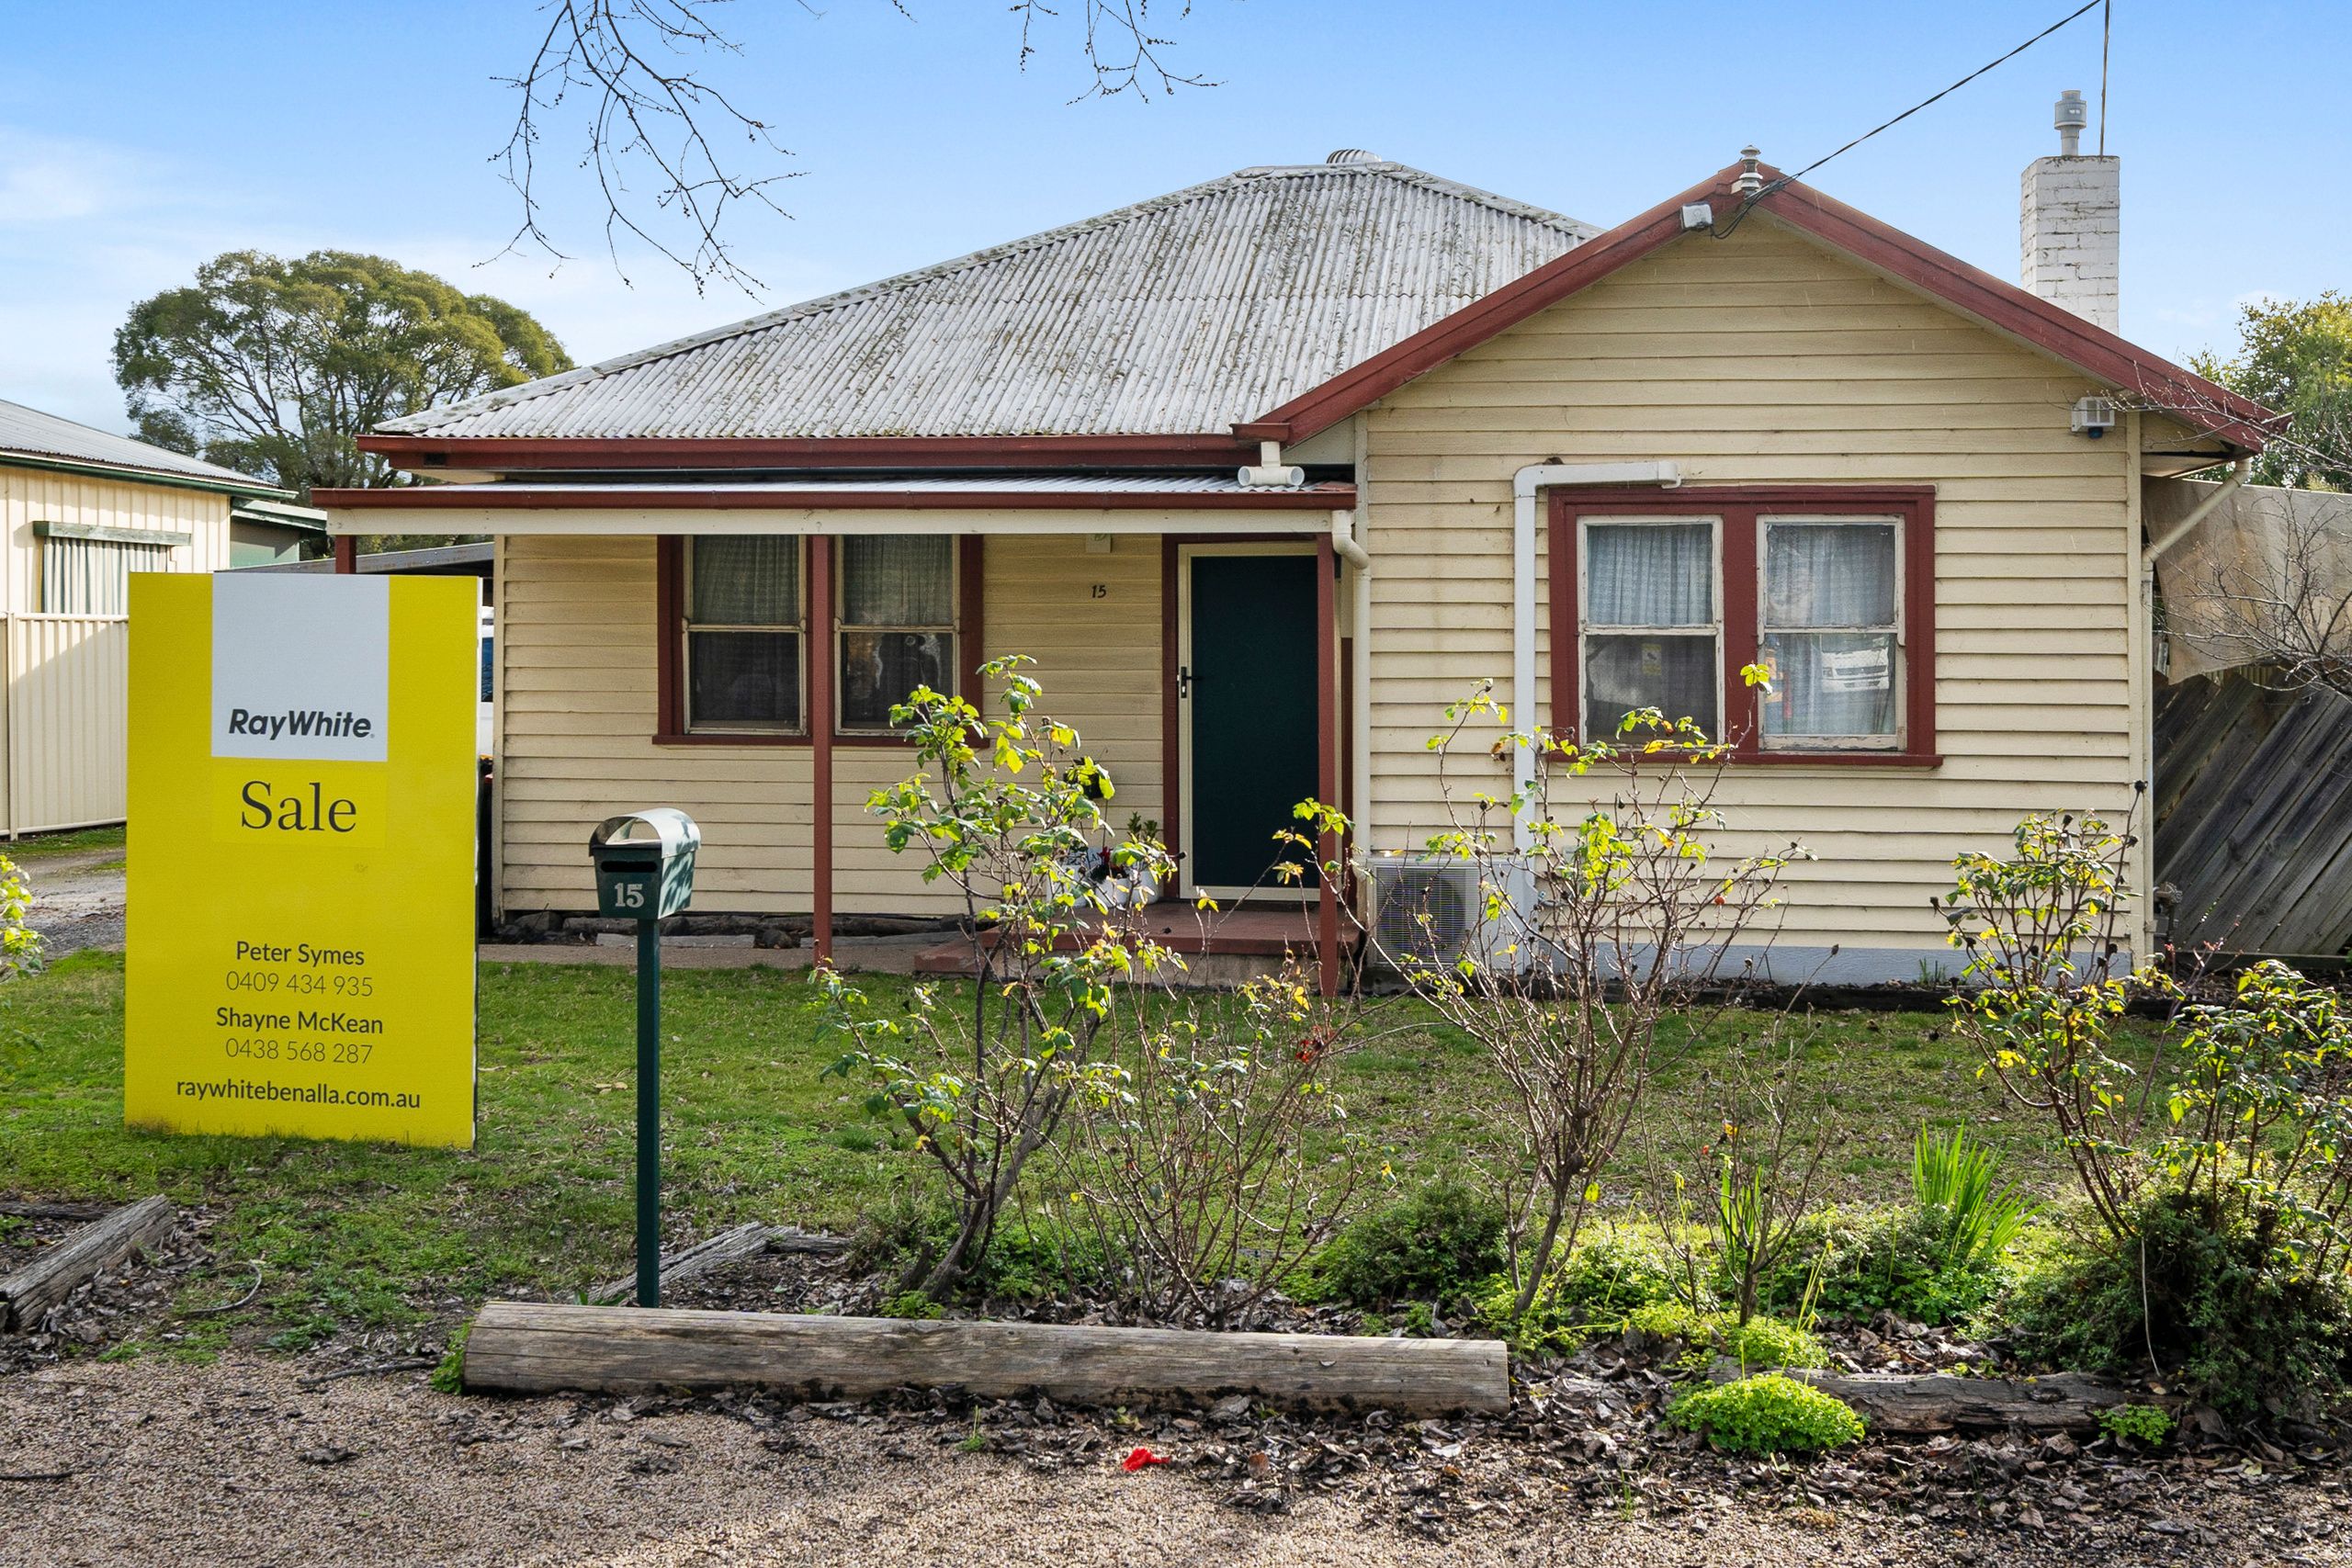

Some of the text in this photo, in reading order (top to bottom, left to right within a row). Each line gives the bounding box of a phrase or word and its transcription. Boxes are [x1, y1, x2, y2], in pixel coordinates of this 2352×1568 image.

[1091, 584, 1107, 599] 15
[228, 708, 372, 741] RayWhite
[241, 780, 356, 833] Sale
[614, 882, 645, 908] 15
[236, 941, 365, 967] Peter Symes
[226, 970, 373, 997] 0409 434 935
[216, 1007, 383, 1034] Shayne McKean
[225, 1038, 373, 1064] 0438 568 287
[175, 1078, 421, 1109] raywhitebenalla.com.au
